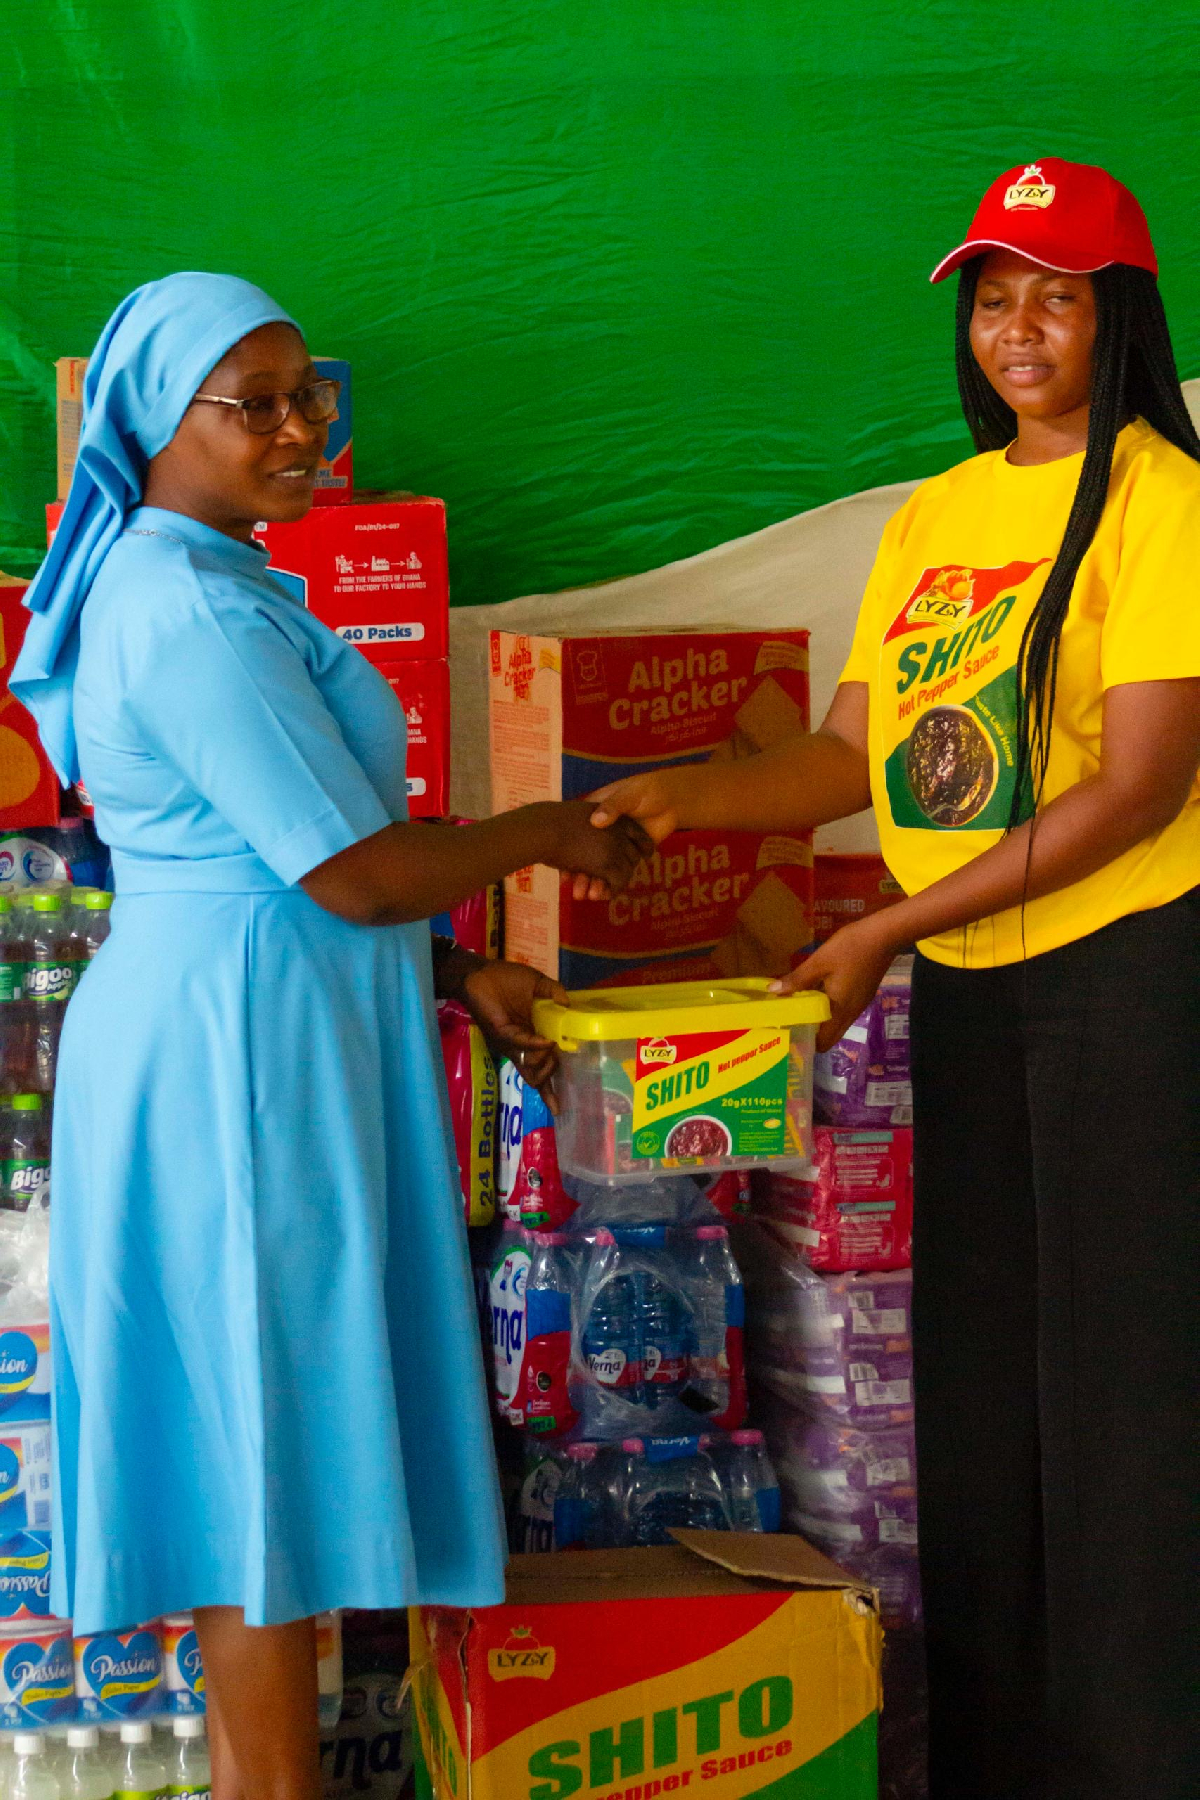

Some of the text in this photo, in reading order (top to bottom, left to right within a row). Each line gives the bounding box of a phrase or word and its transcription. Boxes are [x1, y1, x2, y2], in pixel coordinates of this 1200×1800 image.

[1009, 187, 1049, 199] LYZY
[339, 576, 355, 584] FROM
[367, 575, 393, 583] FARMERS
[355, 584, 381, 592] FACTORY
[914, 599, 967, 618] LYZY
[342, 625, 413, 641] 40 Packs
[896, 595, 1018, 695] SHITO
[628, 647, 730, 693] Alpha
[897, 645, 1001, 721] Hot Pepper Sauce
[608, 676, 748, 731] Cracker
[1000, 735, 1013, 768] Home
[628, 843, 731, 888] Alpha
[608, 872, 750, 927] Cracker
[644, 1047, 674, 1058] LYZY
[758, 1036, 781, 1054] Sauce
[645, 1060, 710, 1111] SHITO
[478, 1056, 495, 1208] 24 Bottles
[590, 1356, 621, 1374] Verna
[12, 1659, 73, 1682] Passion
[90, 1653, 156, 1683] Passion
[496, 1652, 548, 1667] LYZY
[528, 1675, 794, 1800] SHITO
[700, 1738, 793, 1781] Sauce
